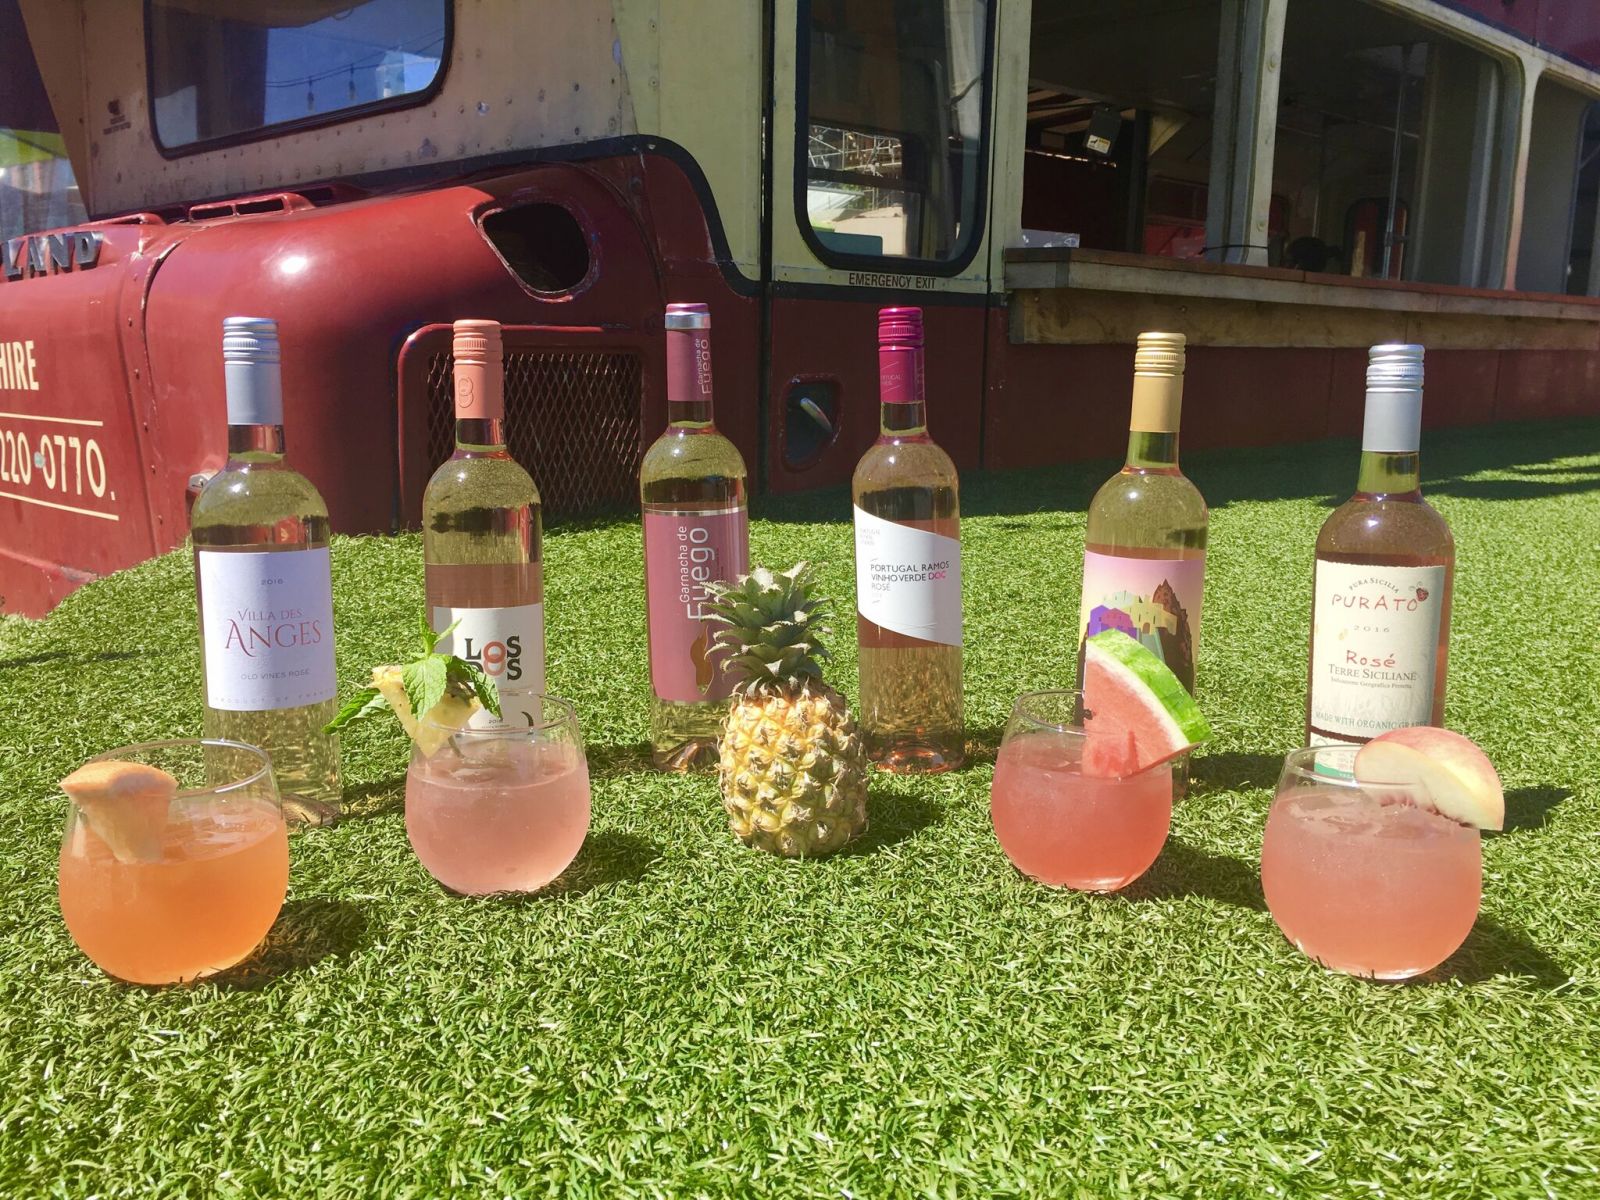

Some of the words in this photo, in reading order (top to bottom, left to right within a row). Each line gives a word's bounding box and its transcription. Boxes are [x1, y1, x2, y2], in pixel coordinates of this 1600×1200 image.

[0, 231, 104, 282] LAND
[849, 273, 911, 288] EMERGENCY
[916, 277, 936, 288] EXIT
[701, 339, 712, 394] Fuego
[678, 526, 688, 541] de
[678, 545, 690, 603] Garnacha
[688, 528, 715, 621] Fuego
[870, 564, 918, 573] PORTUGAL
[921, 561, 950, 571] RAMOS
[871, 574, 897, 582] VINHO
[899, 573, 926, 582] VERDE
[928, 571, 946, 580] DOC
[1370, 577, 1399, 594] SICILIA
[1332, 594, 1418, 612] PURATO
[238, 609, 276, 621] VILLA
[280, 609, 303, 620] DES
[1354, 625, 1390, 633] 2016
[225, 619, 321, 657] ANGES
[464, 635, 522, 664] LOS
[1346, 650, 1396, 668] Rosé
[240, 673, 258, 681] OLD
[261, 671, 287, 679] VINES
[1328, 664, 1359, 678] TERRE
[1335, 715, 1355, 727] WITH
[1357, 719, 1397, 730] ORGANIC
